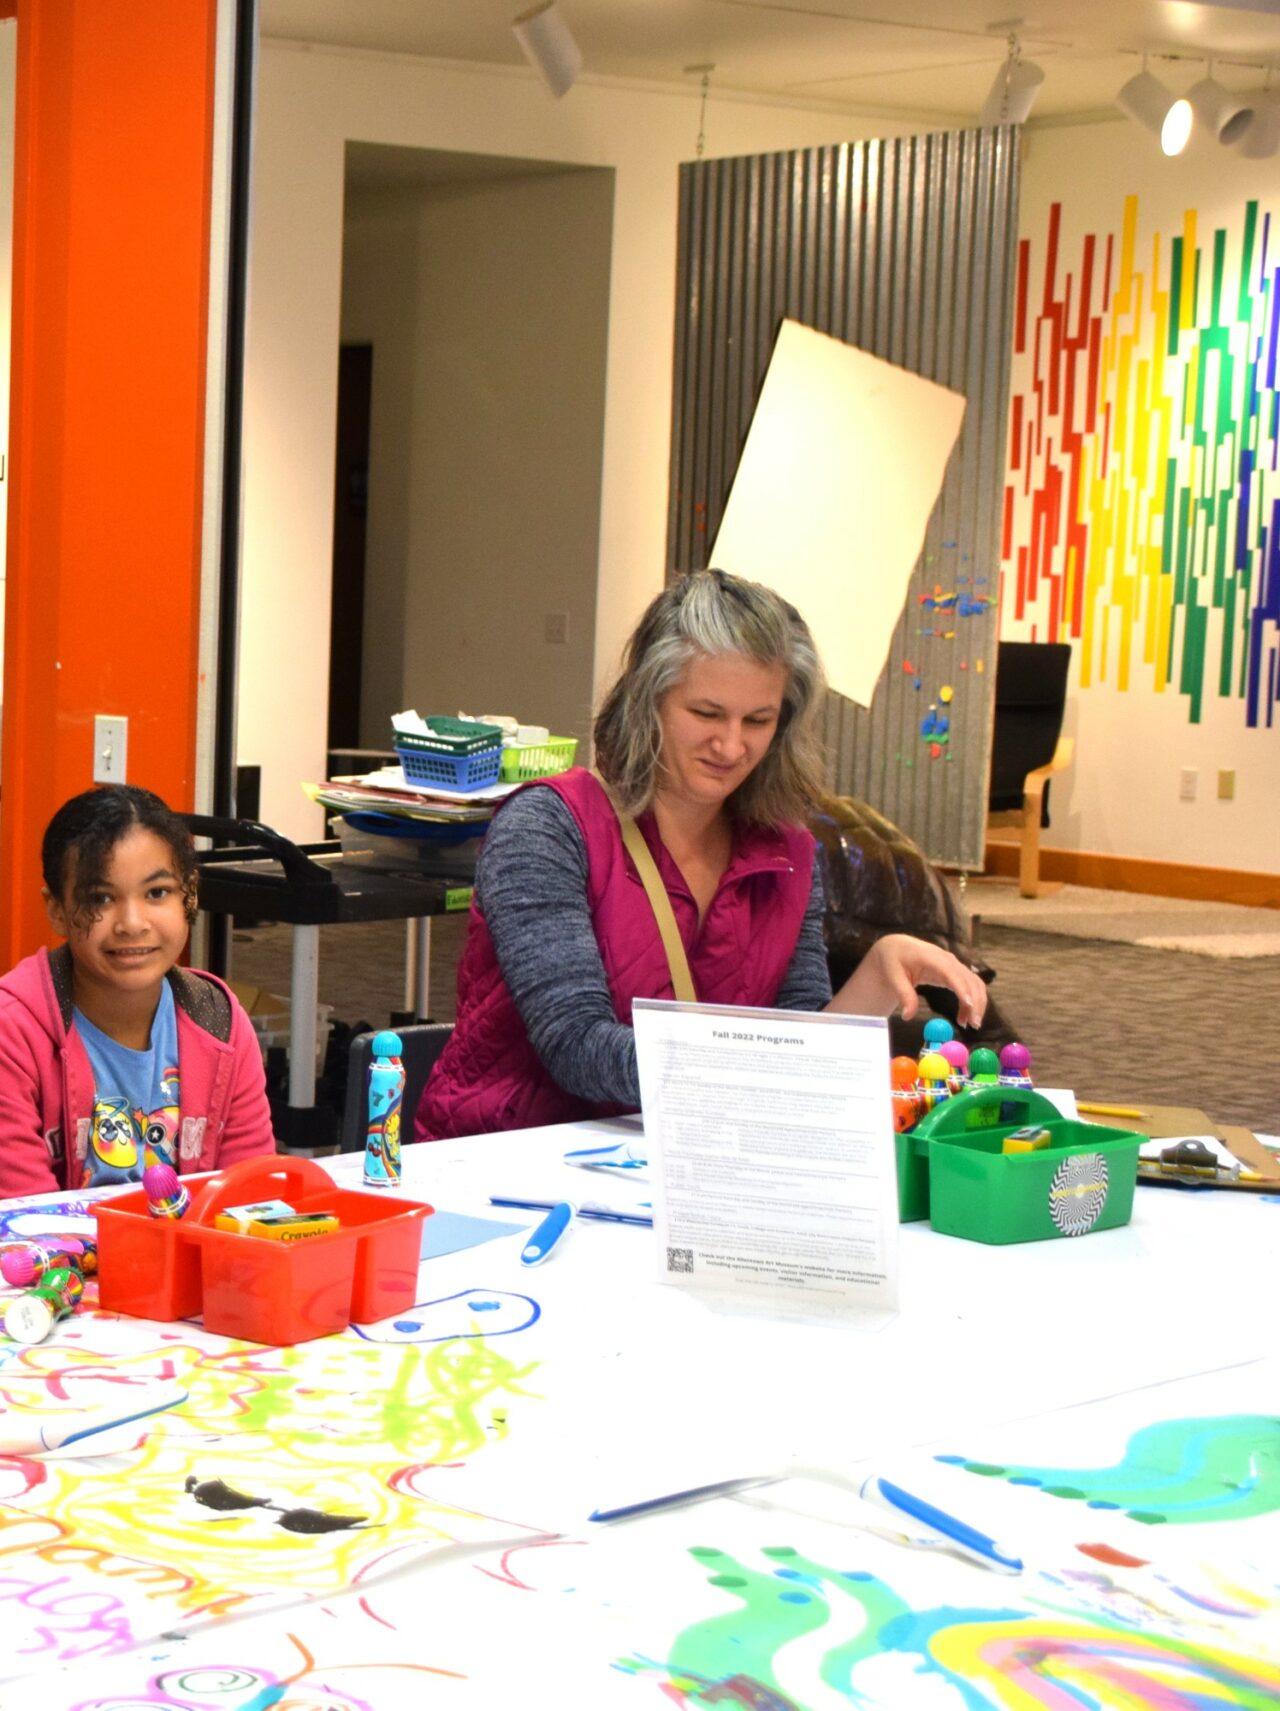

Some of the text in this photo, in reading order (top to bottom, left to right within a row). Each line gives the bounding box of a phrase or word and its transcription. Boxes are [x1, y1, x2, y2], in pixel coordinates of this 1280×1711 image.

[712, 1030, 805, 1046] Fall 2022 Programs
